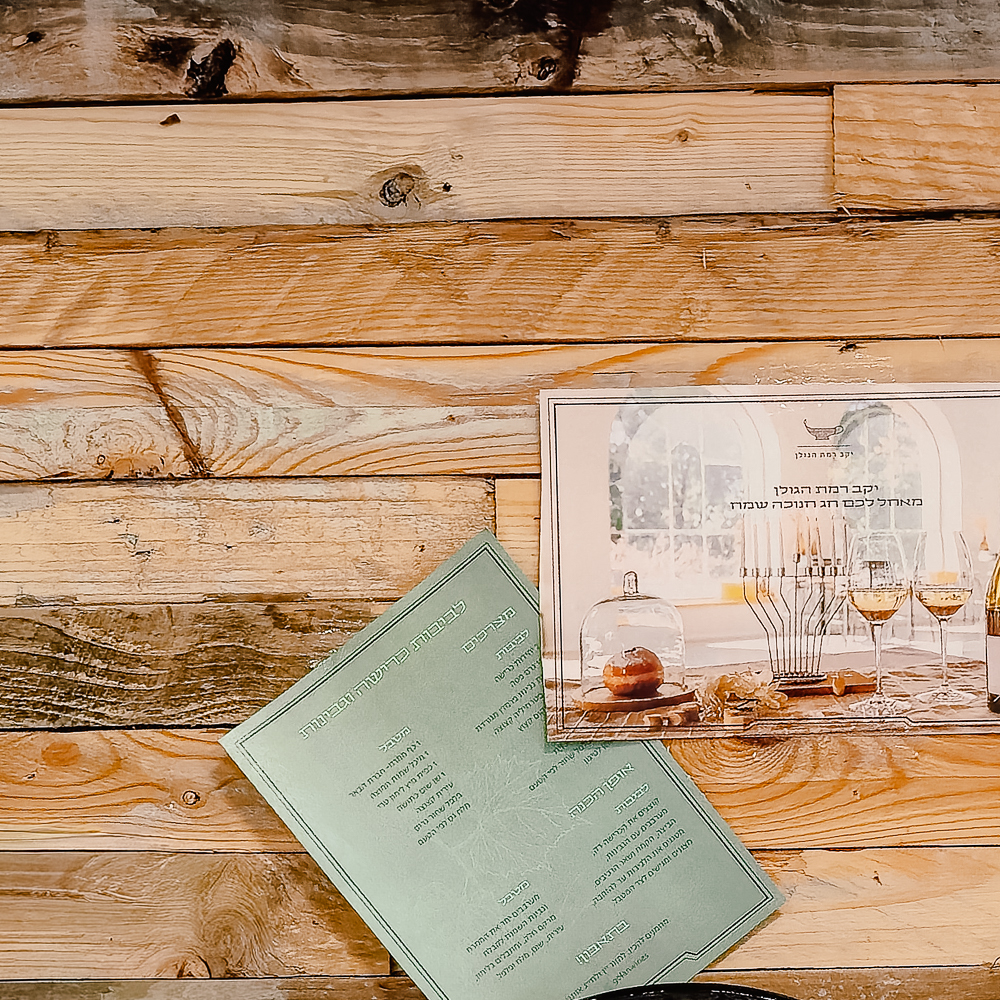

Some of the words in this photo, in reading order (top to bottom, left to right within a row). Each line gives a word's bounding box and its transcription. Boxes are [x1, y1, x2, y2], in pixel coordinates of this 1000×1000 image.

[820, 451, 837, 459] רמת
[840, 451, 854, 459] יקב
[773, 485, 811, 497] הגולן
[815, 484, 849, 494] רמת
[852, 484, 878, 494] יקב
[730, 500, 769, 510] שמח
[772, 499, 817, 510] חנוכה
[820, 499, 839, 508] חג
[843, 498, 875, 508] לכם
[877, 497, 923, 508] מאחל
[410, 601, 467, 650] לביבות
[461, 608, 515, 653] מצרכים
[353, 648, 409, 695] כרישה
[298, 690, 354, 738] וגבינות
[378, 727, 410, 752] מטבל
[602, 764, 634, 792] אופן
[567, 787, 604, 818] הכנה
[497, 880, 529, 905] מטבל
[575, 921, 629, 964] בתאבון!
